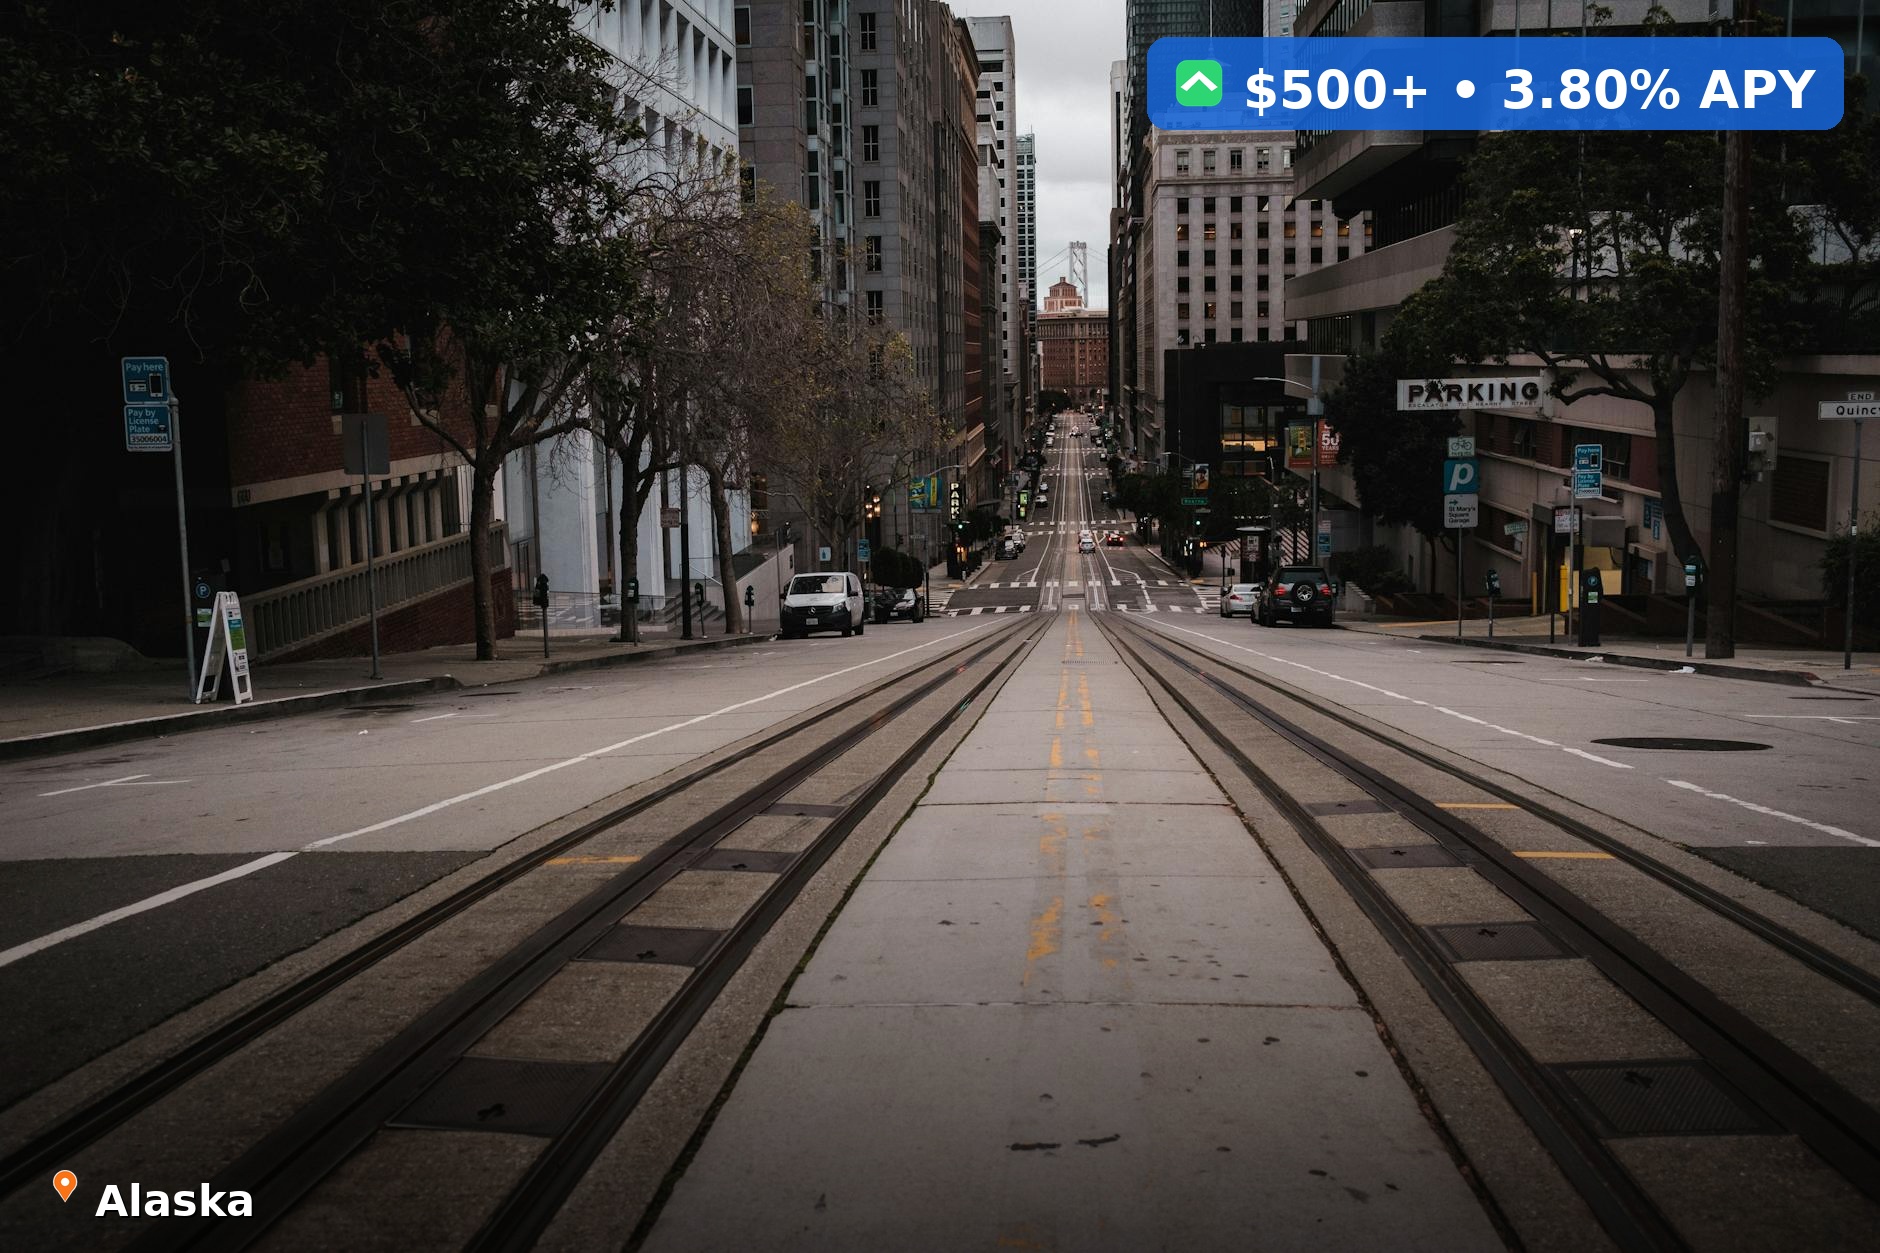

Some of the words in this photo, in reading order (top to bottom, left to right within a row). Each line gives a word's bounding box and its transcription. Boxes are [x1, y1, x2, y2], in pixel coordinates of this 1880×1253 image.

[125, 362, 142, 373] Pay
[143, 361, 164, 371] here
[1408, 382, 1539, 402] PARKING
[128, 409, 144, 418] Pay
[145, 409, 156, 418] by
[1836, 405, 1880, 416] Quinc
[129, 417, 160, 425] License
[129, 425, 151, 433] Plate
